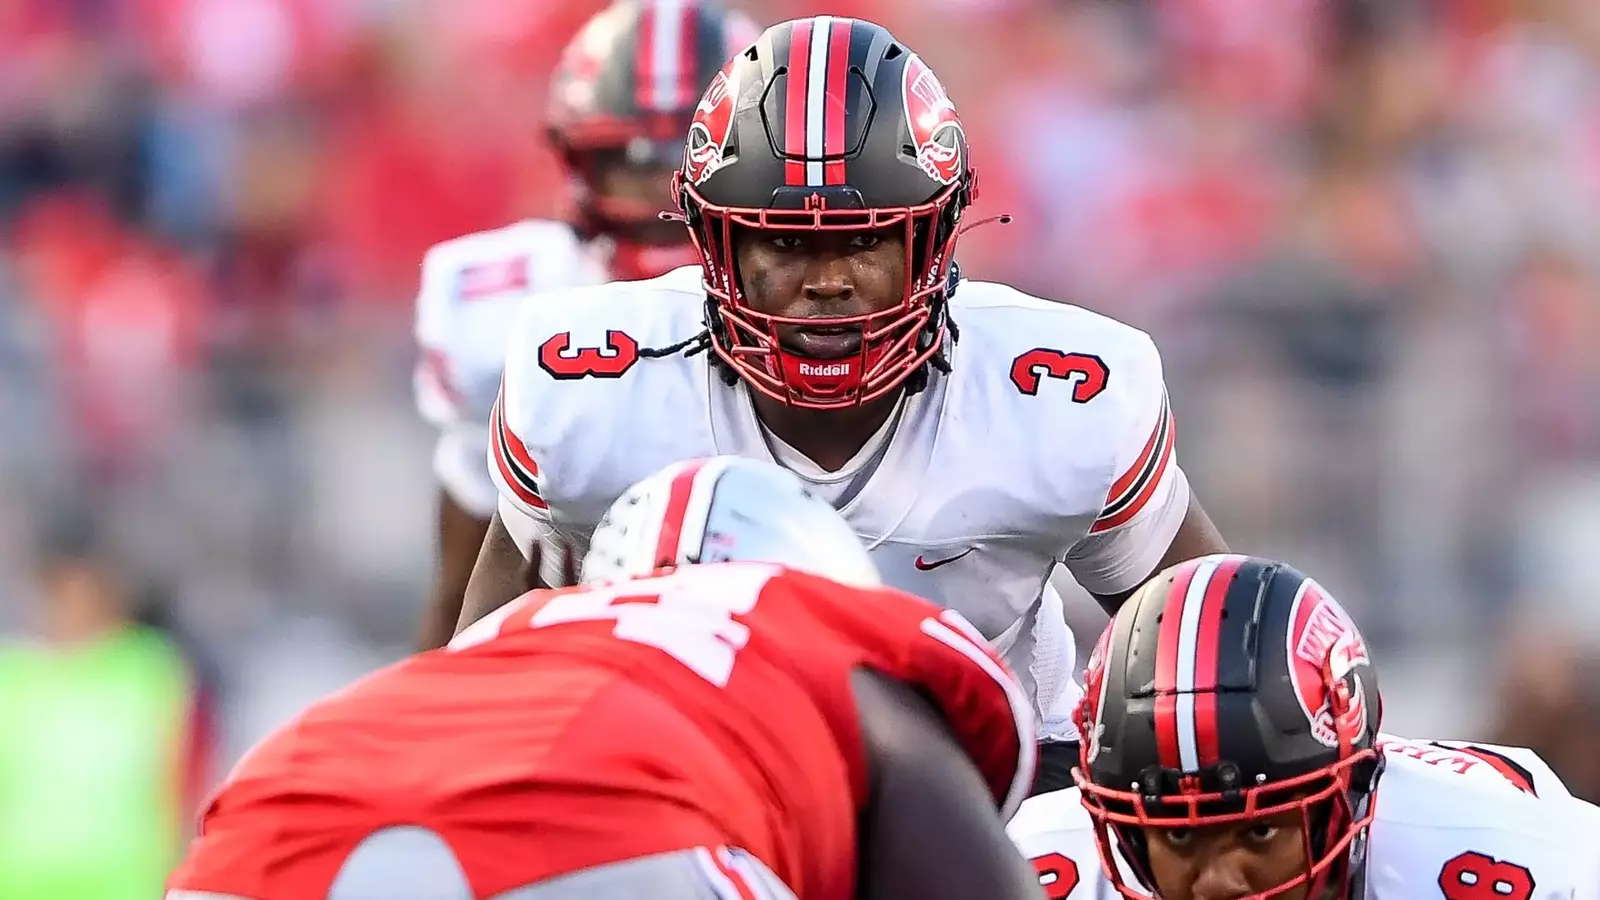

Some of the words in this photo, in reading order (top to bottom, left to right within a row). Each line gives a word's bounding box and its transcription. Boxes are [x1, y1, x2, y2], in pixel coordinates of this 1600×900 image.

[538, 329, 639, 380] 3
[799, 362, 850, 376] Riddell
[1010, 347, 1110, 404] 3
[1437, 850, 1536, 900] 8
